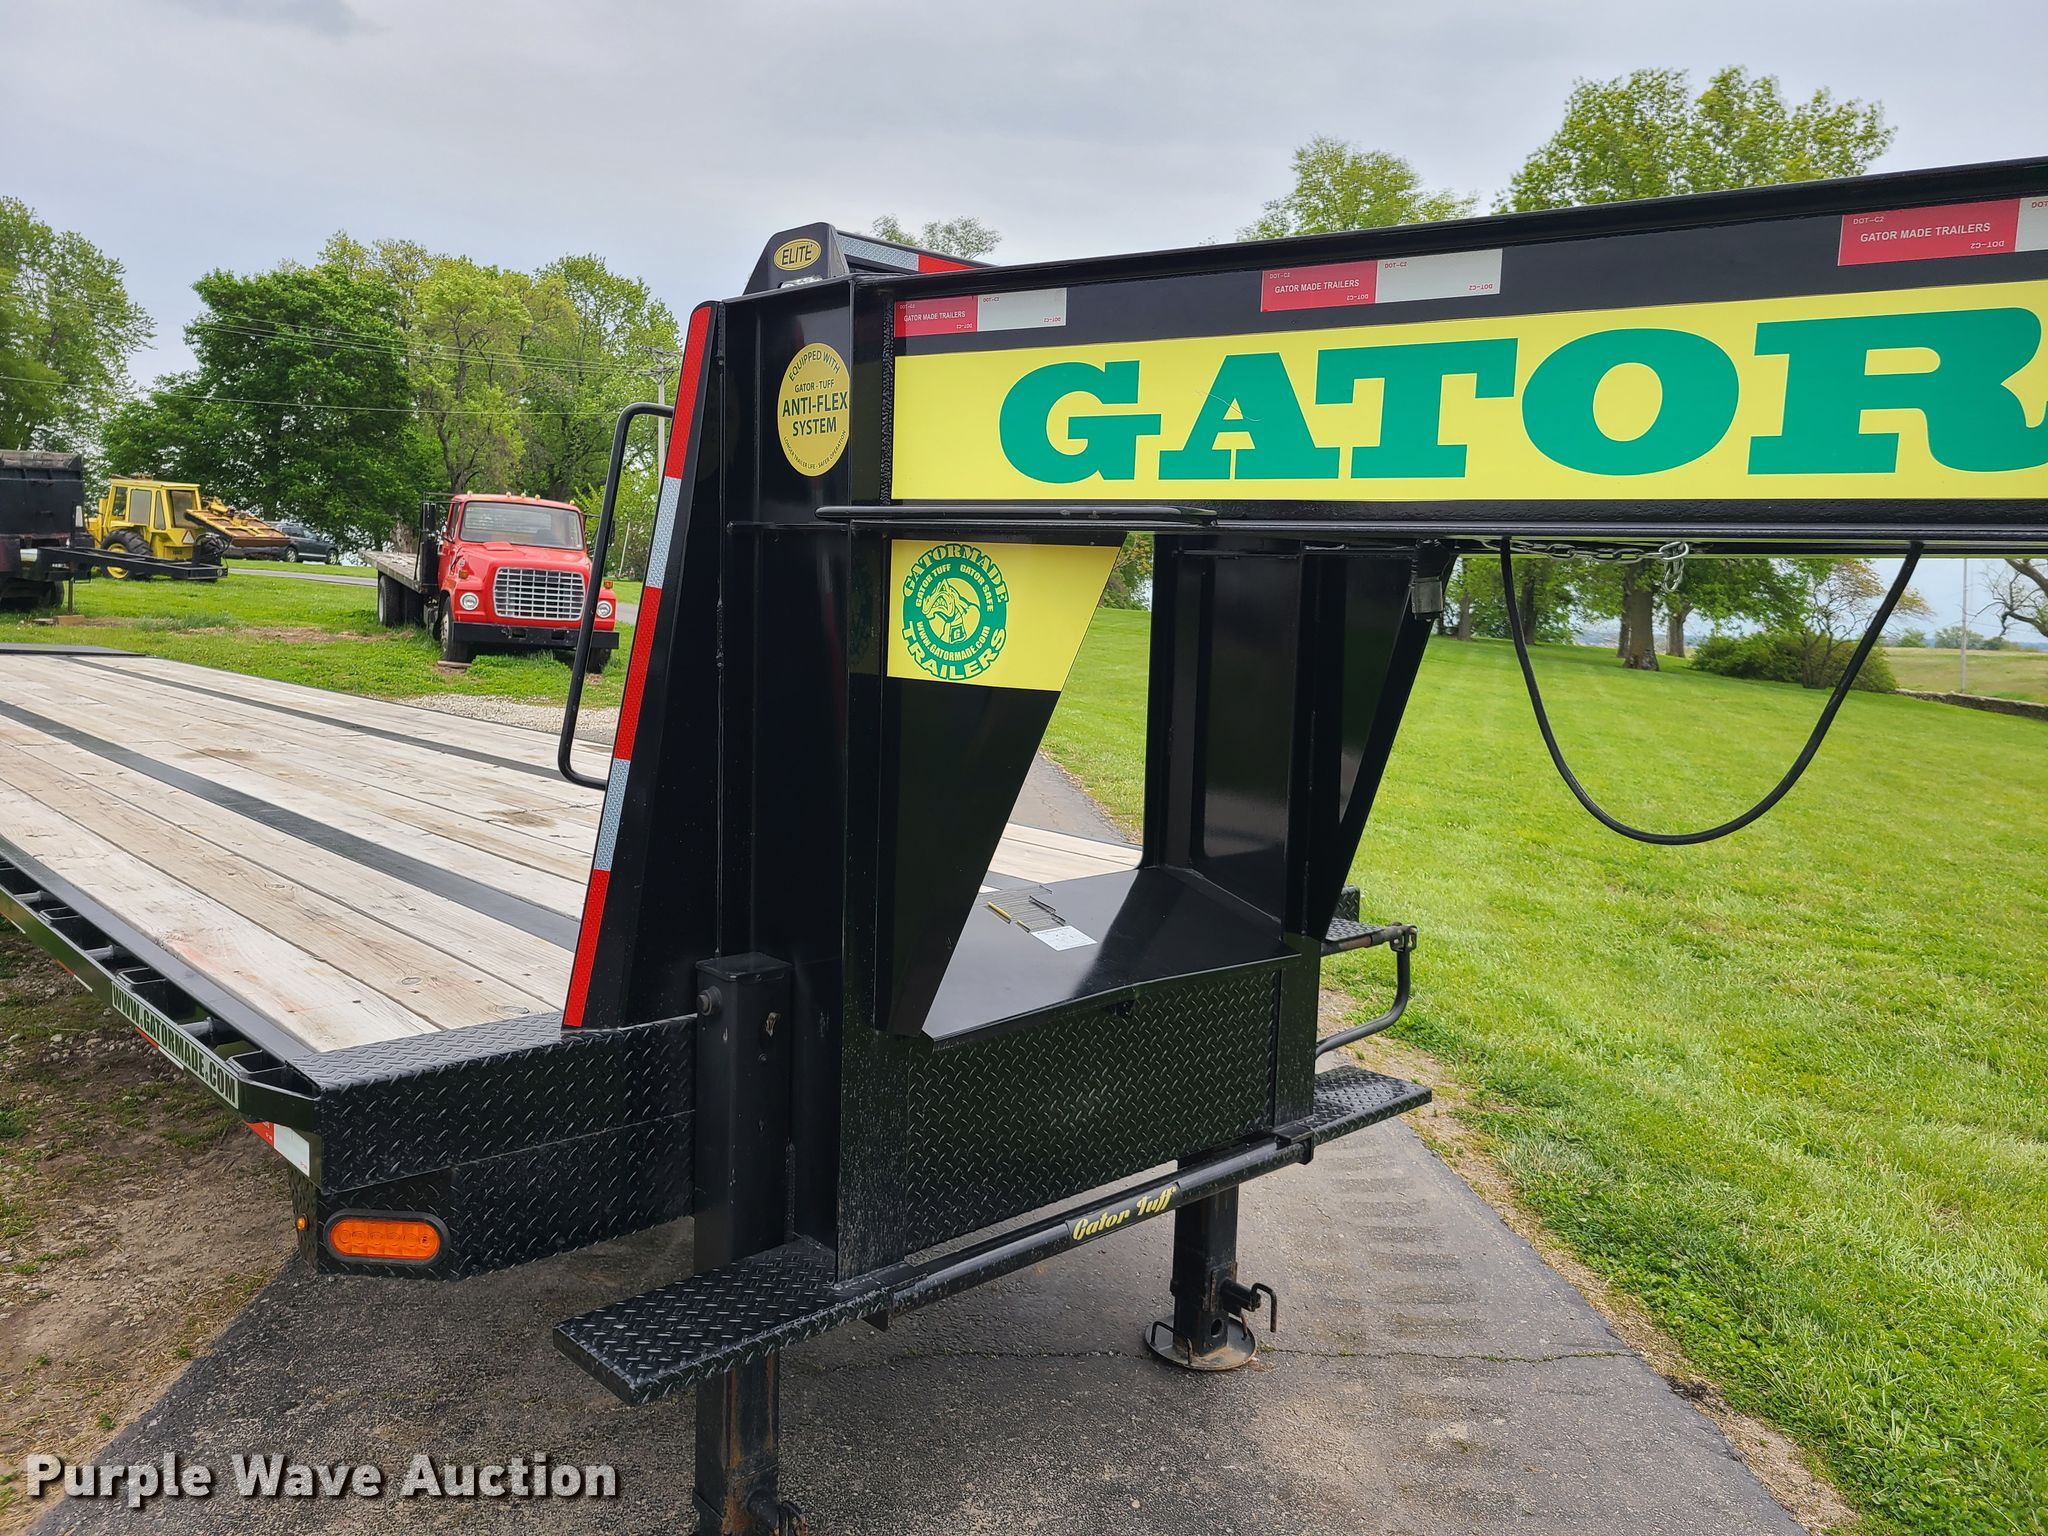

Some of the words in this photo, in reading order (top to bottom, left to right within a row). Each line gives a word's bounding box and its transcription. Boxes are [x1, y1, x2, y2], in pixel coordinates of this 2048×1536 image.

[1853, 216, 1884, 225] DOT-C2
[1860, 230, 1897, 243] GATOR
[1900, 227, 1932, 239] MADE
[1935, 222, 1991, 236] TRAILERS
[781, 244, 812, 265] ELITE
[1384, 261, 1407, 269] DOT-C2
[1274, 283, 1300, 294] GATOR
[1300, 282, 1322, 291] MADE
[1323, 279, 1359, 290] TRAILERS
[904, 312, 922, 322] GATOR
[922, 312, 938, 320] MADE
[938, 310, 966, 319] TRAILERS
[788, 350, 822, 382] EQUIPPED
[823, 351, 841, 374] WITH
[794, 382, 815, 393] GATOR
[819, 379, 834, 390] TUFF
[999, 307, 2048, 484] GATOR
[782, 391, 848, 417] ANTI-FLEX
[792, 417, 837, 436] SYSTEM
[902, 544, 1009, 603] GATORMADE
[916, 575, 933, 607] GATOR
[930, 564, 951, 577] TUFF
[960, 564, 985, 585] GATOR
[982, 585, 994, 612] SAFE
[902, 621, 1007, 680] TRAILERS
[112, 985, 236, 1103] WWW.GATORMADE.COM
[1072, 1209, 1130, 1240] Gator
[1136, 1186, 1176, 1215] Tuff
